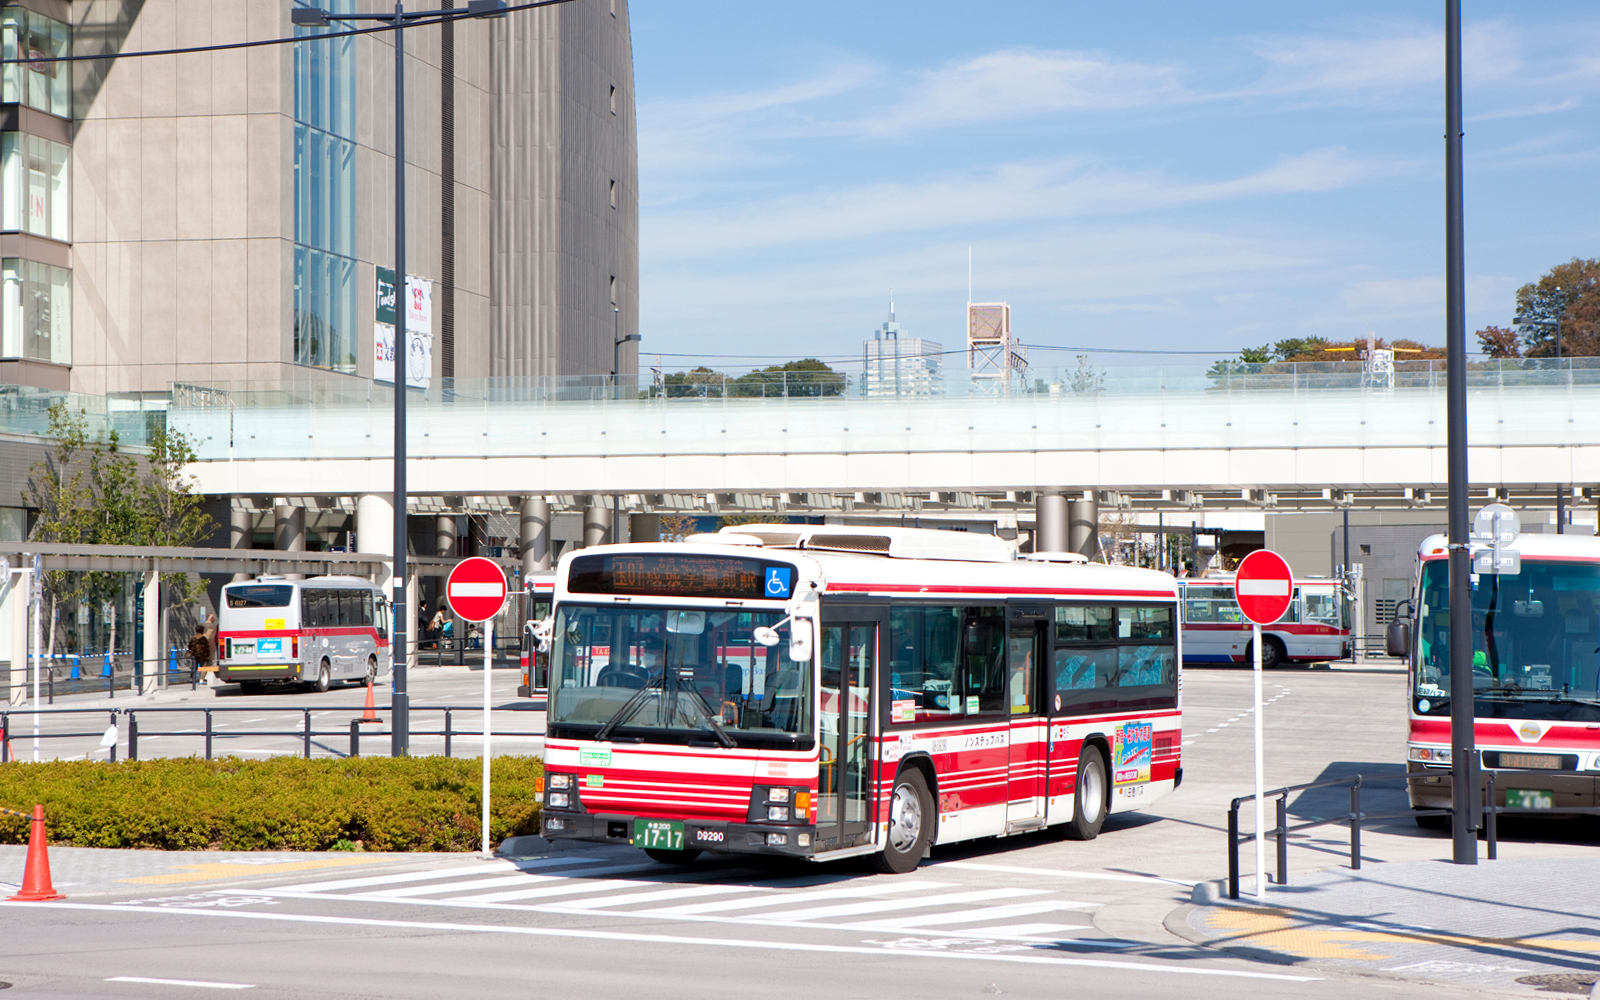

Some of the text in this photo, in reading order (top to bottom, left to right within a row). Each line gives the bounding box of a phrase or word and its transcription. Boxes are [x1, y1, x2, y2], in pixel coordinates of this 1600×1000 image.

[964, 734, 1005, 748] ノンステップバス
[1501, 754, 1559, 770] 羽田空港
[644, 828, 683, 849] 17-17
[697, 830, 724, 842] D9290
